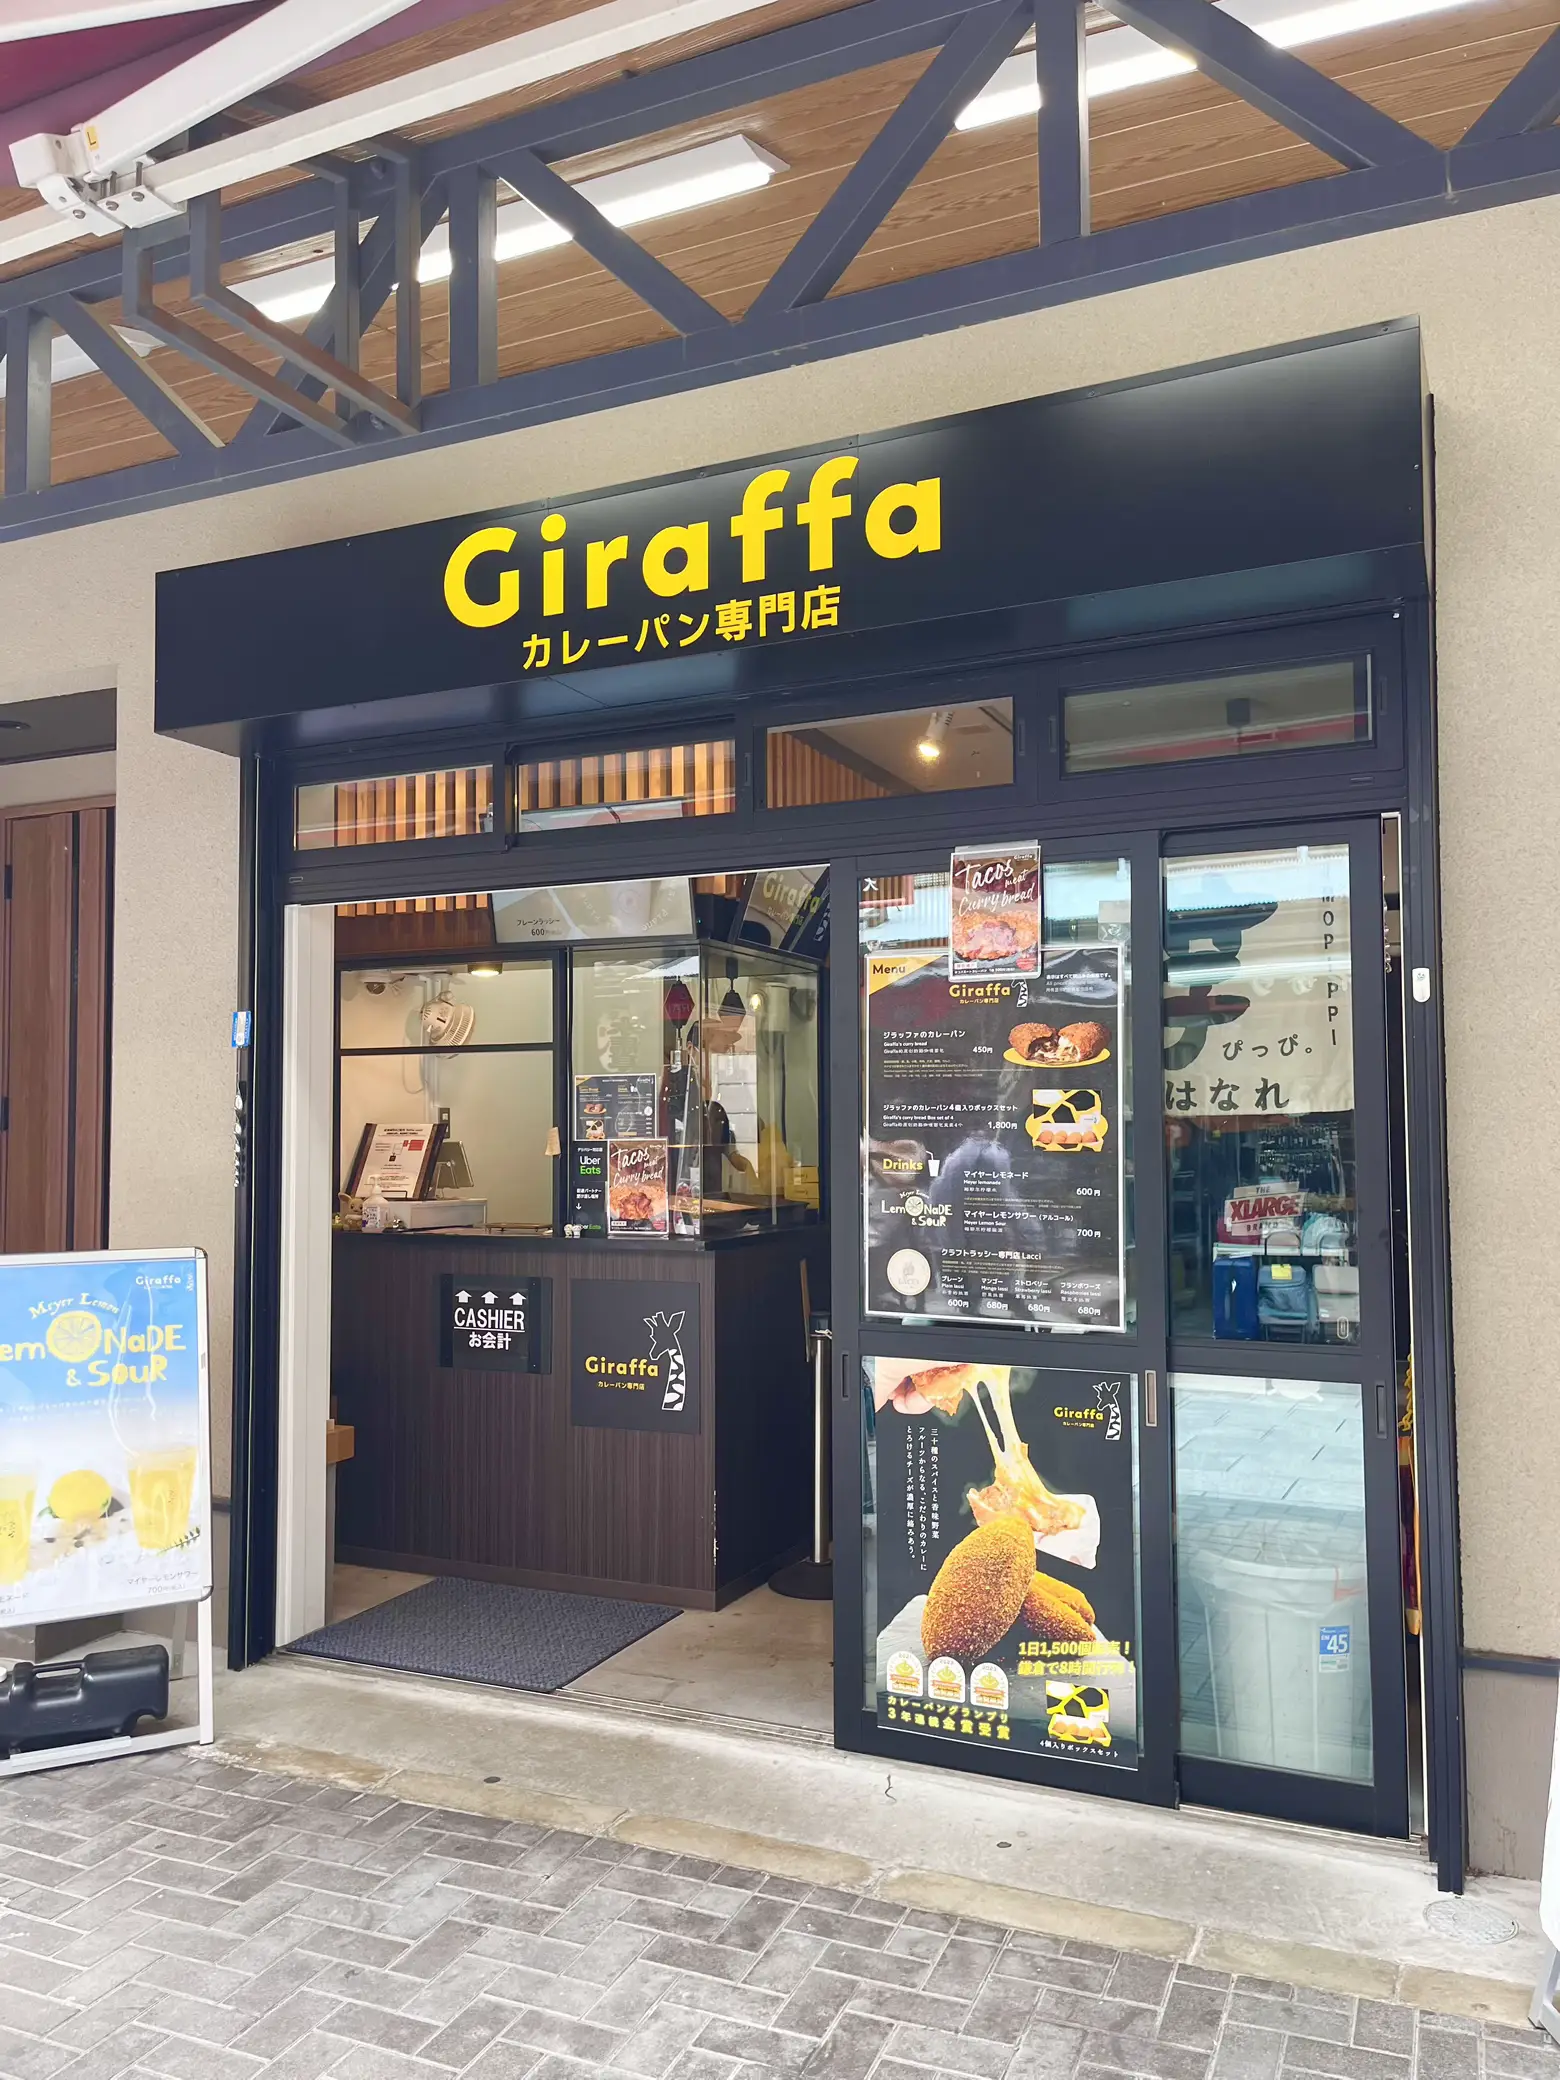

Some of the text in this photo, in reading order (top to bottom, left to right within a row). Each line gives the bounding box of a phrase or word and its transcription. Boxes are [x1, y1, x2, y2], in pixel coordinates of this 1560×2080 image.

[443, 456, 941, 628] Giraffa
[522, 585, 841, 670] カレーパン専門店
[954, 859, 1014, 894] Tacos
[1005, 869, 1029, 887] meat
[958, 883, 1035, 917] Curry bread
[872, 964, 906, 975] Menu
[949, 983, 1011, 997] Giraffa
[883, 1030, 966, 1039] ジラッファのカレーパン
[972, 1046, 993, 1054] 450円
[1222, 1033, 1313, 1061] ぴっぴ。
[1165, 1076, 1290, 1111] はなれ
[883, 1104, 1018, 1112] ジラッファのカレーパン4個入りボックスセット
[987, 1121, 1018, 1130] 1,800円
[580, 1156, 601, 1165] Uber
[611, 1147, 650, 1172] Tacos
[882, 1158, 924, 1171] Drinks
[580, 1166, 601, 1174] Eats
[963, 1170, 1029, 1179] マイヤーレモネード
[613, 1166, 664, 1188] Curry bread
[963, 1210, 1037, 1220] マイヤーレモンサワー
[941, 1248, 1042, 1260] クラフトラッシー専門店 Lacci
[135, 1274, 182, 1285] Giraffa
[942, 1275, 964, 1283] プレーン
[981, 1277, 1004, 1285] マンゴー
[1014, 1279, 1048, 1287] ストロベリー
[1060, 1282, 1101, 1290] フランボワーズ
[28, 1298, 74, 1320] Meyer
[947, 1299, 969, 1308] 600円
[986, 1301, 1009, 1311] 680円
[1027, 1303, 1051, 1313] 680円
[1077, 1306, 1101, 1316] 680円
[454, 1307, 525, 1330] CASHIER
[468, 1331, 512, 1350] お会計
[585, 1356, 659, 1377] Giraffa
[66, 1368, 82, 1387] &
[597, 1380, 645, 1391] カレーパン専門店
[1053, 1406, 1104, 1421] Giraffa
[930, 1428, 940, 1539] 三十種のスパイスと香味野菜
[1326, 1633, 1349, 1653] 45
[887, 1695, 1009, 1724] カレーパングランプリ
[1039, 1740, 1119, 1758] 4個入りボックスセット
